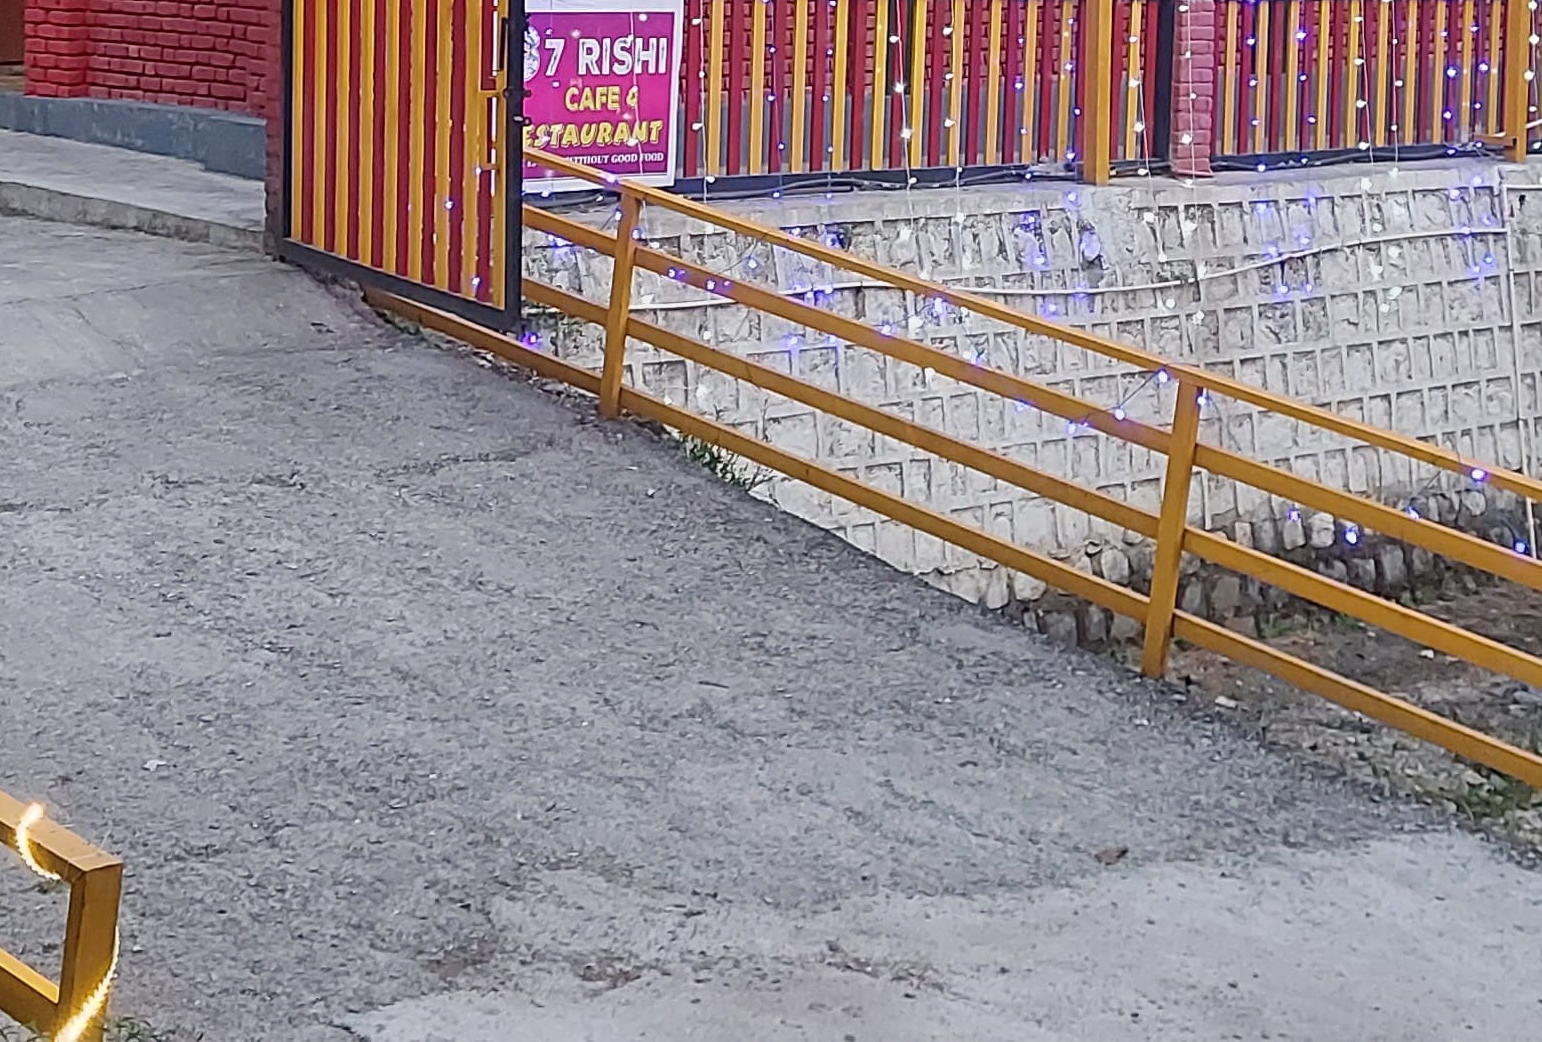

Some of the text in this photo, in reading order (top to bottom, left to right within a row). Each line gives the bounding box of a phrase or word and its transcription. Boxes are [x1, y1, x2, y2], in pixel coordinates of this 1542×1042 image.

[545, 37, 668, 77] 7 RISHI
[565, 86, 620, 111] CAFE
[611, 153, 638, 164] GOOD
